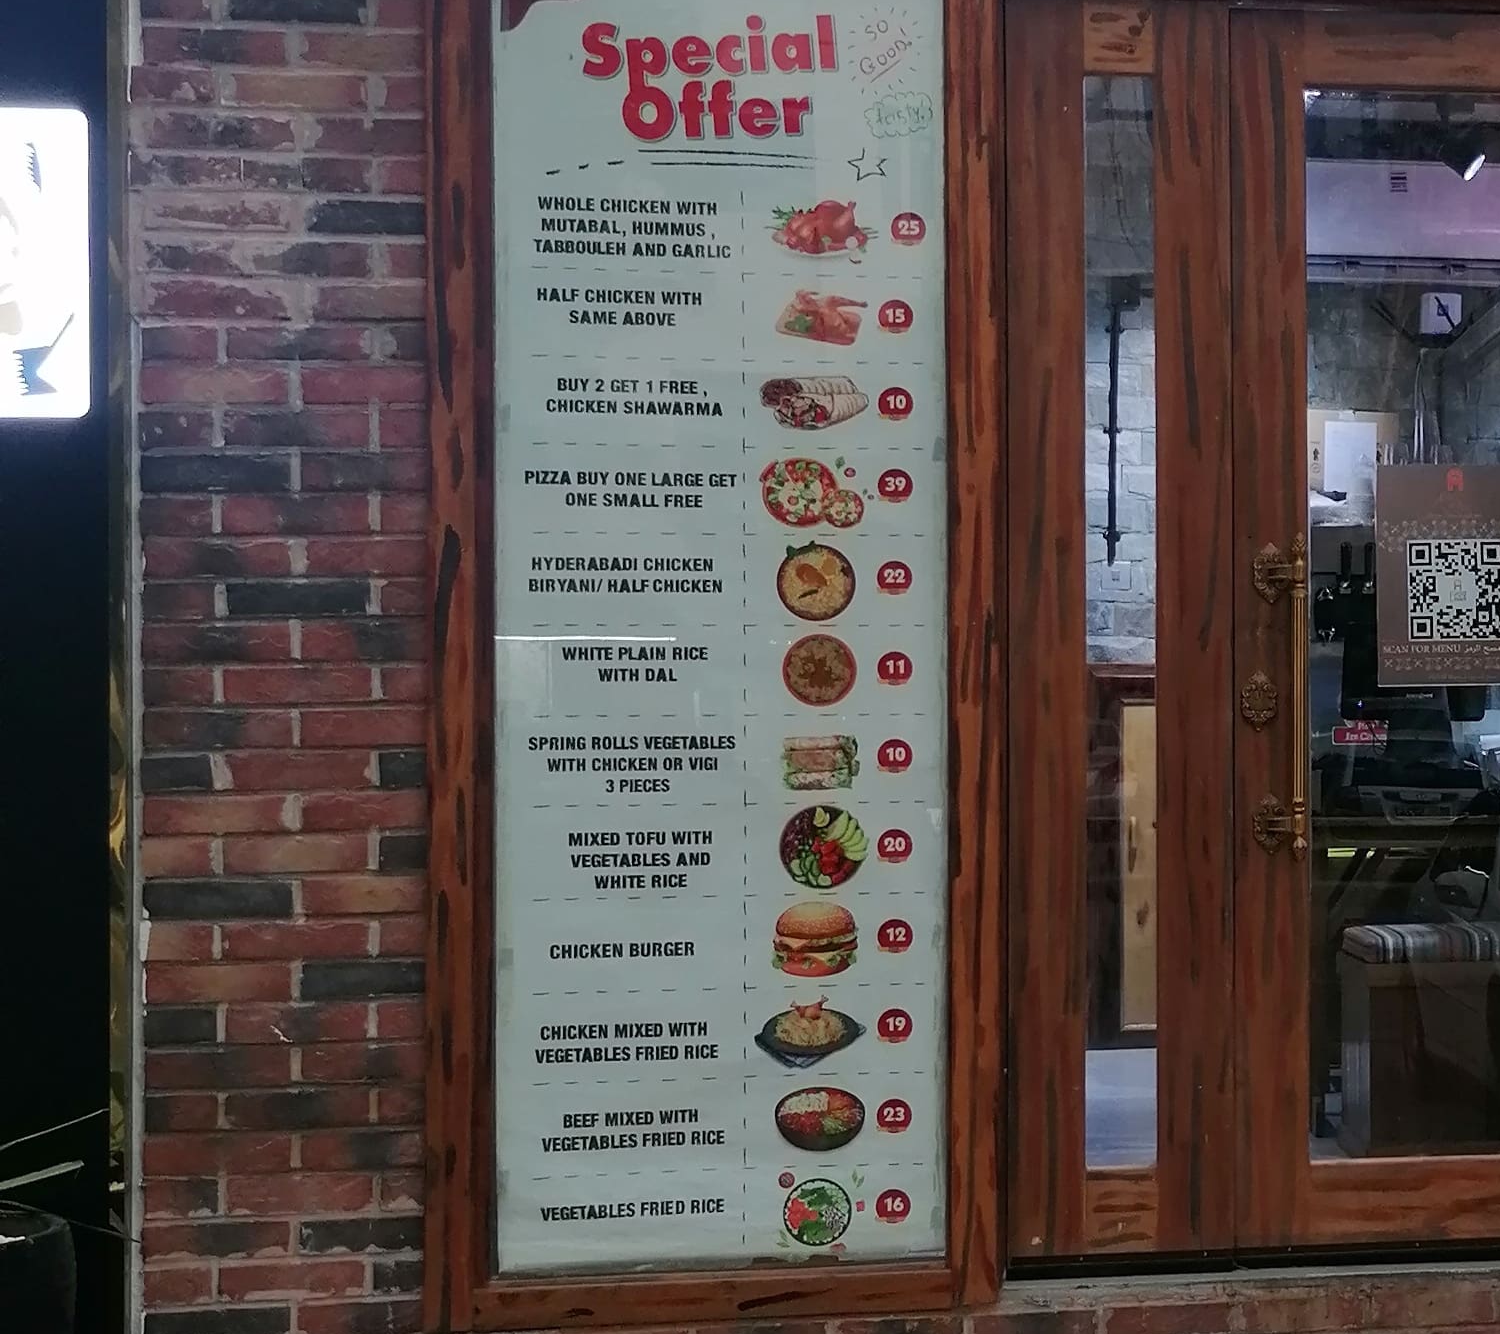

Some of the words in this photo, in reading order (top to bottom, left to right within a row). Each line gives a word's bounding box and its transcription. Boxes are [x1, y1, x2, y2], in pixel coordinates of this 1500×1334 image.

[582, 14, 838, 85] Special
[622, 79, 813, 142] Offer
[537, 195, 595, 212] WHOLE
[600, 198, 671, 215] CHICKEN
[676, 201, 717, 216] WITH
[898, 220, 920, 236] 25
[632, 242, 667, 257] AND
[671, 243, 731, 259] GARLIC
[536, 287, 579, 303] HALF
[584, 288, 655, 305] CHICKEN
[661, 291, 702, 306] WITH
[569, 309, 617, 325] SAME
[622, 311, 676, 327] ABOVE
[886, 307, 905, 323] 15
[557, 377, 589, 392] BUY
[595, 378, 605, 393] 2
[610, 379, 639, 393] GET
[646, 380, 653, 393] 1
[546, 398, 617, 414] CHICKEN
[623, 400, 723, 417] SHAWARMA
[887, 395, 906, 411] 10
[524, 470, 572, 485] PIZZA
[576, 471, 610, 486] BUY
[614, 471, 647, 487] ONE
[651, 472, 704, 487] LARGE
[708, 473, 737, 488] GET
[885, 477, 907, 492] 39
[565, 492, 598, 507] ONE
[602, 492, 660, 508] SMALL
[531, 556, 638, 572] HYDERABADI
[643, 557, 714, 572] CHICKEN
[884, 569, 906, 585] 22
[607, 578, 649, 594] HALF
[652, 578, 723, 594] CHICKEN
[561, 646, 614, 661] WHITE
[618, 646, 666, 661] PLAIN
[672, 646, 709, 661] RICE
[1383, 644, 1409, 654] SCAN
[1411, 644, 1430, 654] FOR
[1432, 644, 1461, 654] MENU
[597, 667, 640, 683] WITH
[645, 667, 678, 683] DAL
[887, 660, 906, 676] 11
[528, 736, 587, 751] SPRING
[591, 735, 639, 751] ROLLS
[643, 735, 736, 751] VEGETABLES
[887, 747, 907, 762] 10
[547, 757, 586, 773] WITH
[591, 757, 658, 772] CHICKEN
[662, 756, 683, 771] OR
[605, 778, 615, 793] 3
[619, 778, 670, 793] PIECES
[568, 832, 621, 847] MIXED
[625, 831, 666, 846] TOFU
[671, 830, 713, 845] WITH
[884, 837, 906, 853] 20
[570, 852, 671, 868] VEGETABLES
[675, 851, 711, 867] AND
[594, 874, 646, 890] WHITE
[651, 873, 688, 889] RICE
[887, 927, 907, 943] 12
[549, 942, 624, 960] CHICKEN
[629, 941, 695, 958] BURGER
[540, 1024, 609, 1041] CHICKEN
[614, 1022, 664, 1039] MIXED
[667, 1021, 708, 1038] WITH
[887, 1017, 906, 1033] 19
[534, 1046, 631, 1064] VEGETABLES
[635, 1045, 679, 1061] FRIED
[684, 1044, 719, 1060] RICE
[563, 1112, 600, 1129] BEEF
[604, 1110, 655, 1127] MIXED
[658, 1108, 699, 1125] WITH
[883, 1107, 905, 1123] 23
[541, 1133, 638, 1153] VEGETABLES
[642, 1131, 686, 1148] FRIED
[691, 1129, 725, 1146] RICE
[540, 1202, 636, 1222] VEGETABLES
[640, 1200, 686, 1217] FRIED
[690, 1198, 725, 1215] RICE
[885, 1197, 905, 1213] 16
